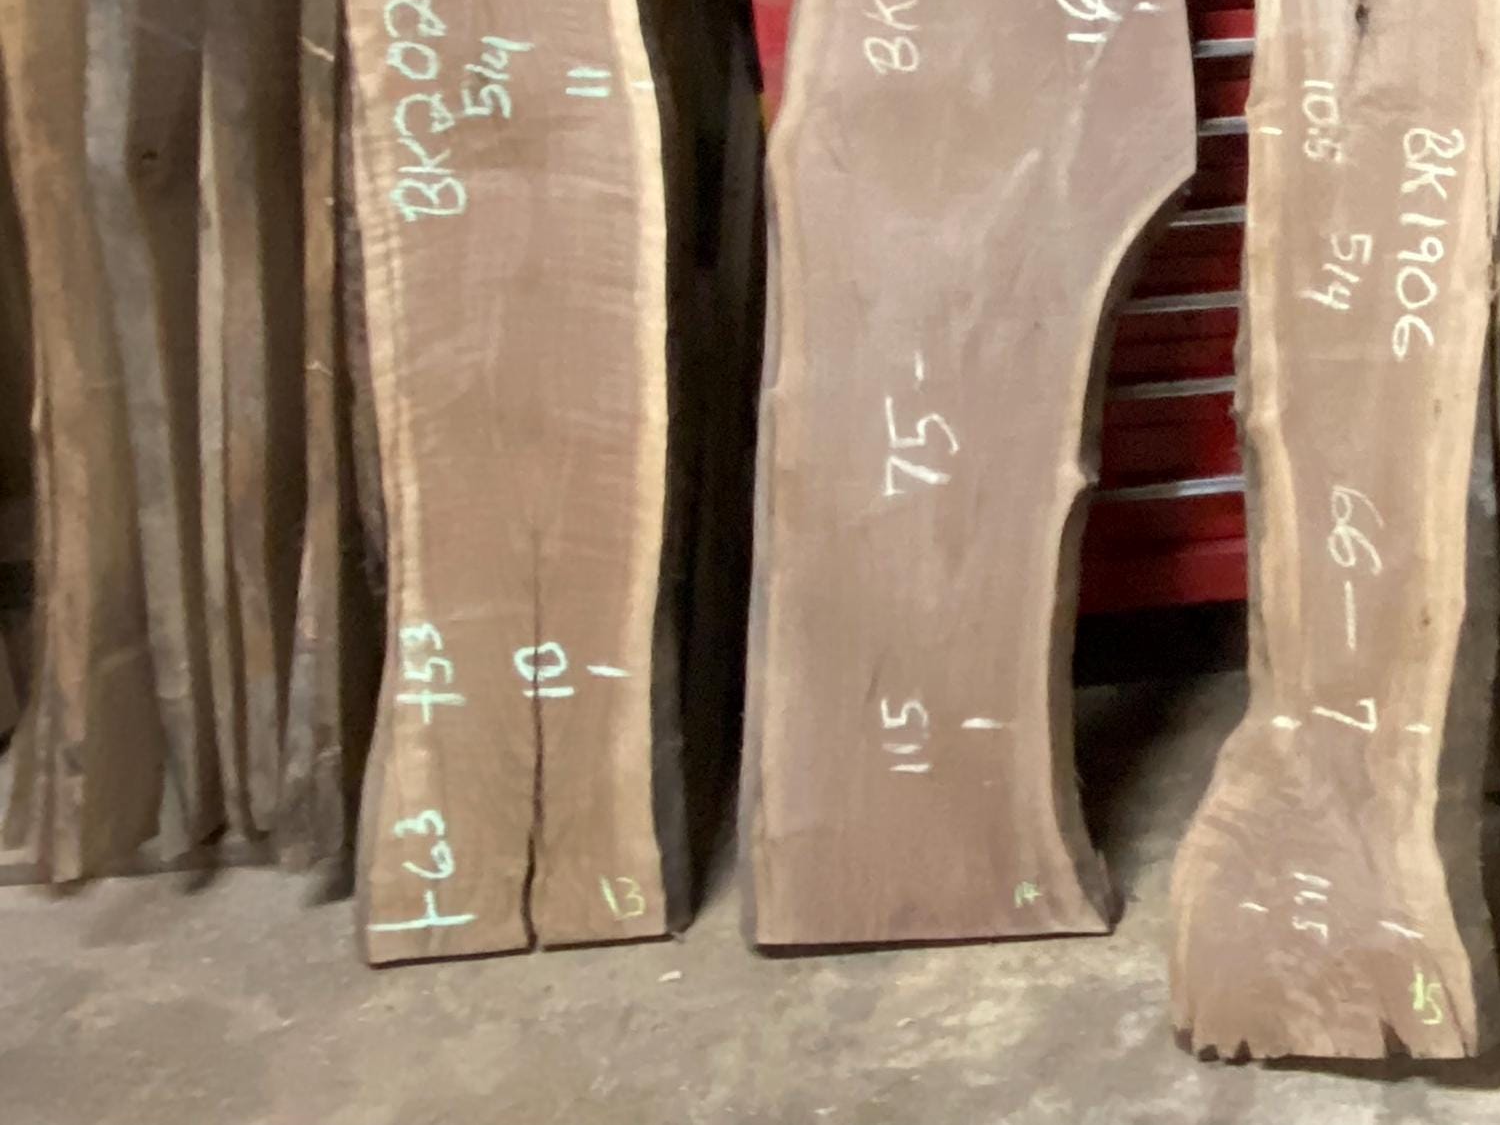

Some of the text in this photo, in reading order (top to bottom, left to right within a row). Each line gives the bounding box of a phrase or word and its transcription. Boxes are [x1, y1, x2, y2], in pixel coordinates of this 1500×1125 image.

[1391, 127, 1466, 362] BK1906
[513, 641, 576, 698] 10
[599, 876, 647, 921] 13
[1408, 971, 1443, 1025] 15
